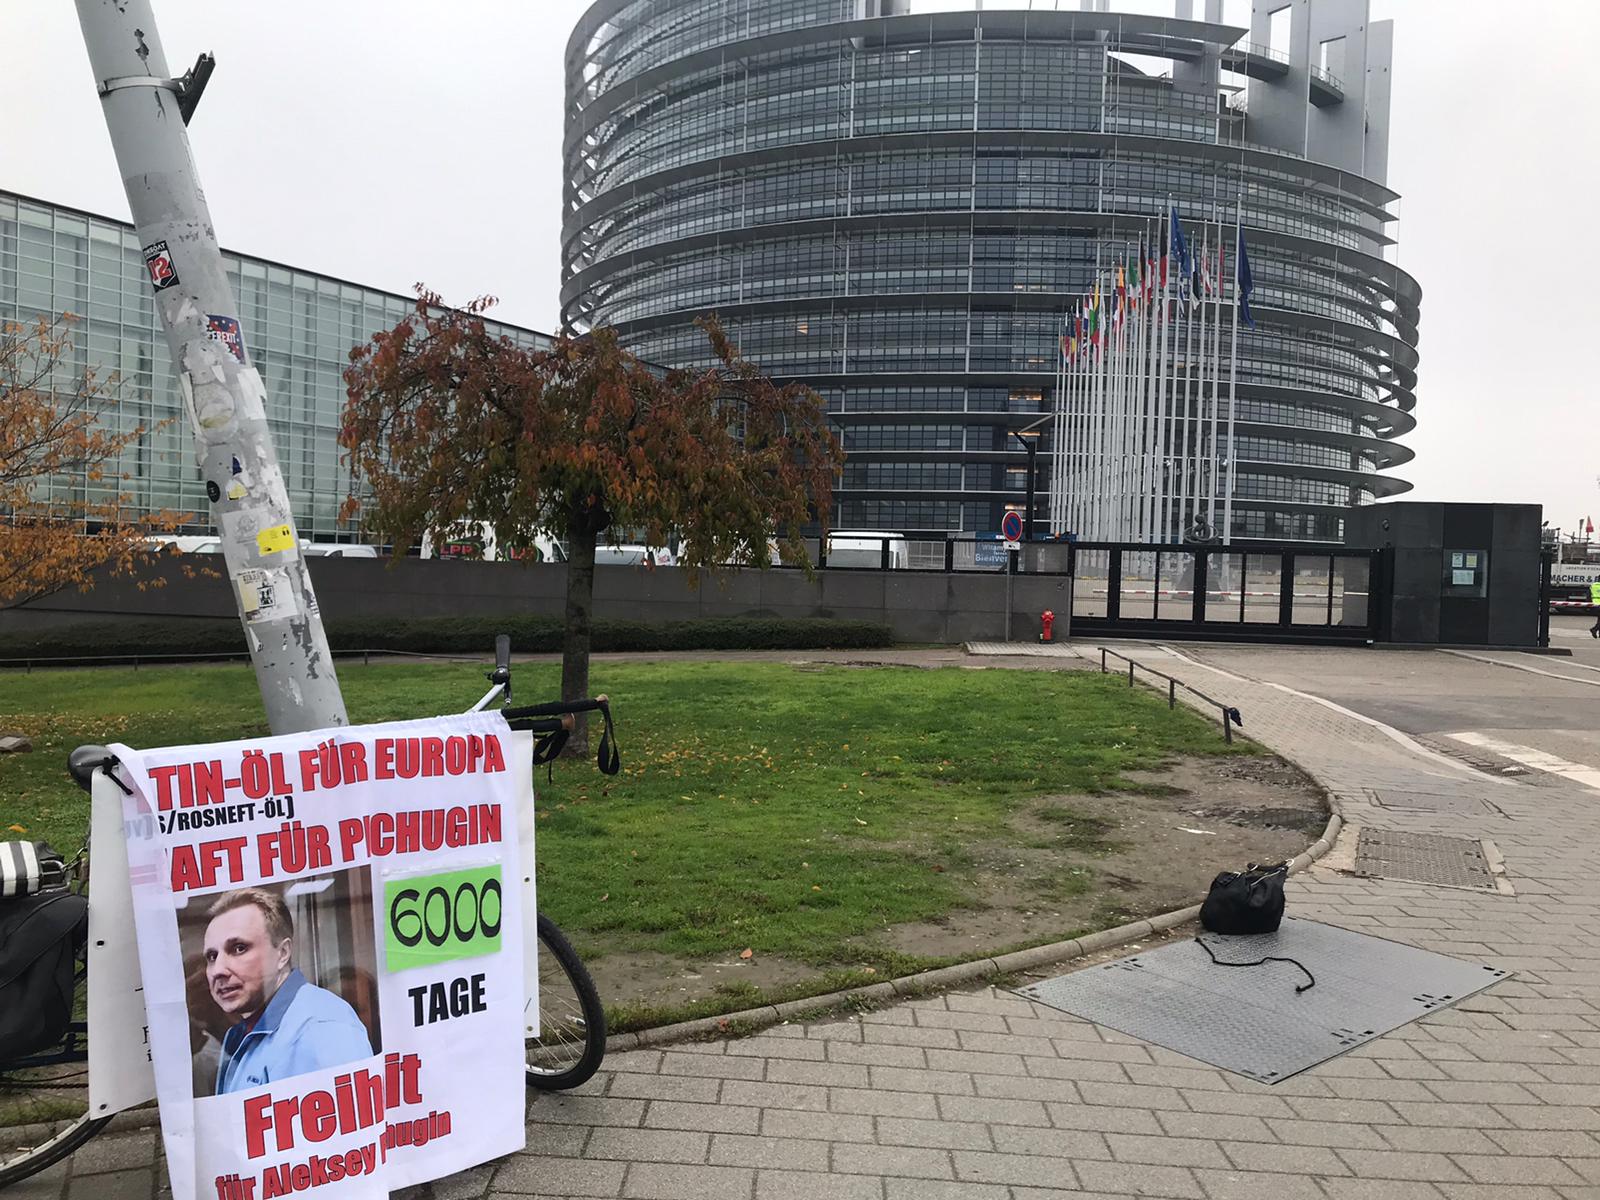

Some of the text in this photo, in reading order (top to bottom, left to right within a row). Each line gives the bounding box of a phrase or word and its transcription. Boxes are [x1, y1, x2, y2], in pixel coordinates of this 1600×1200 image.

[299, 738, 368, 792] FÜR
[375, 734, 506, 780] EUROPA
[165, 804, 502, 892] AFT FÜR PICHUGIN
[390, 878, 502, 947] 6000
[408, 973, 487, 1027] TAGE
[244, 1052, 422, 1160] Freihit
[262, 1142, 376, 1200] Aleksey
